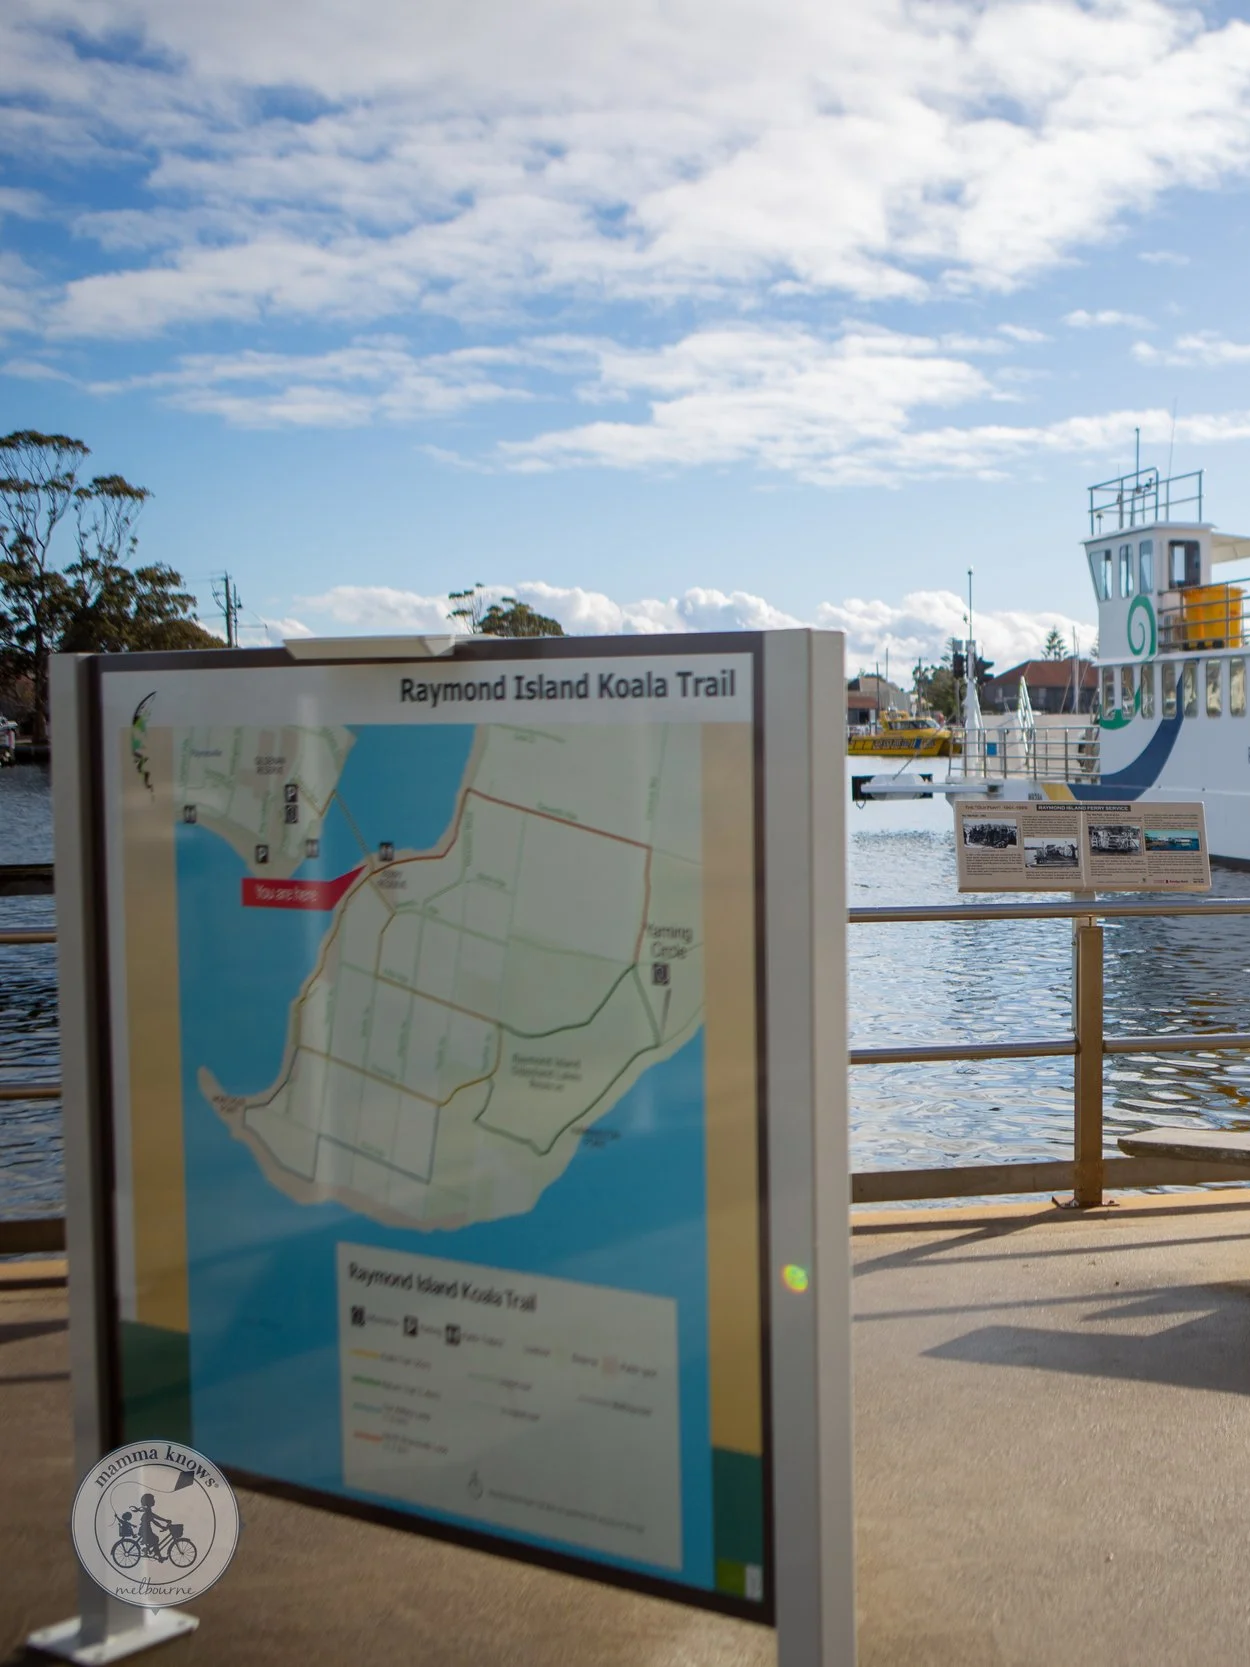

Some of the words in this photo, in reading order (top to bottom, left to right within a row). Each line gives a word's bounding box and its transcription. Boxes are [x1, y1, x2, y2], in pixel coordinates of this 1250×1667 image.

[400, 675, 508, 708] Raymond
[515, 673, 588, 700] Island
[597, 671, 668, 699] Koala
[675, 669, 736, 698] Trail
[347, 1260, 413, 1291] Raymond
[416, 1273, 458, 1299] Island
[460, 1280, 503, 1308] Koala
[503, 1287, 538, 1313] Trail
